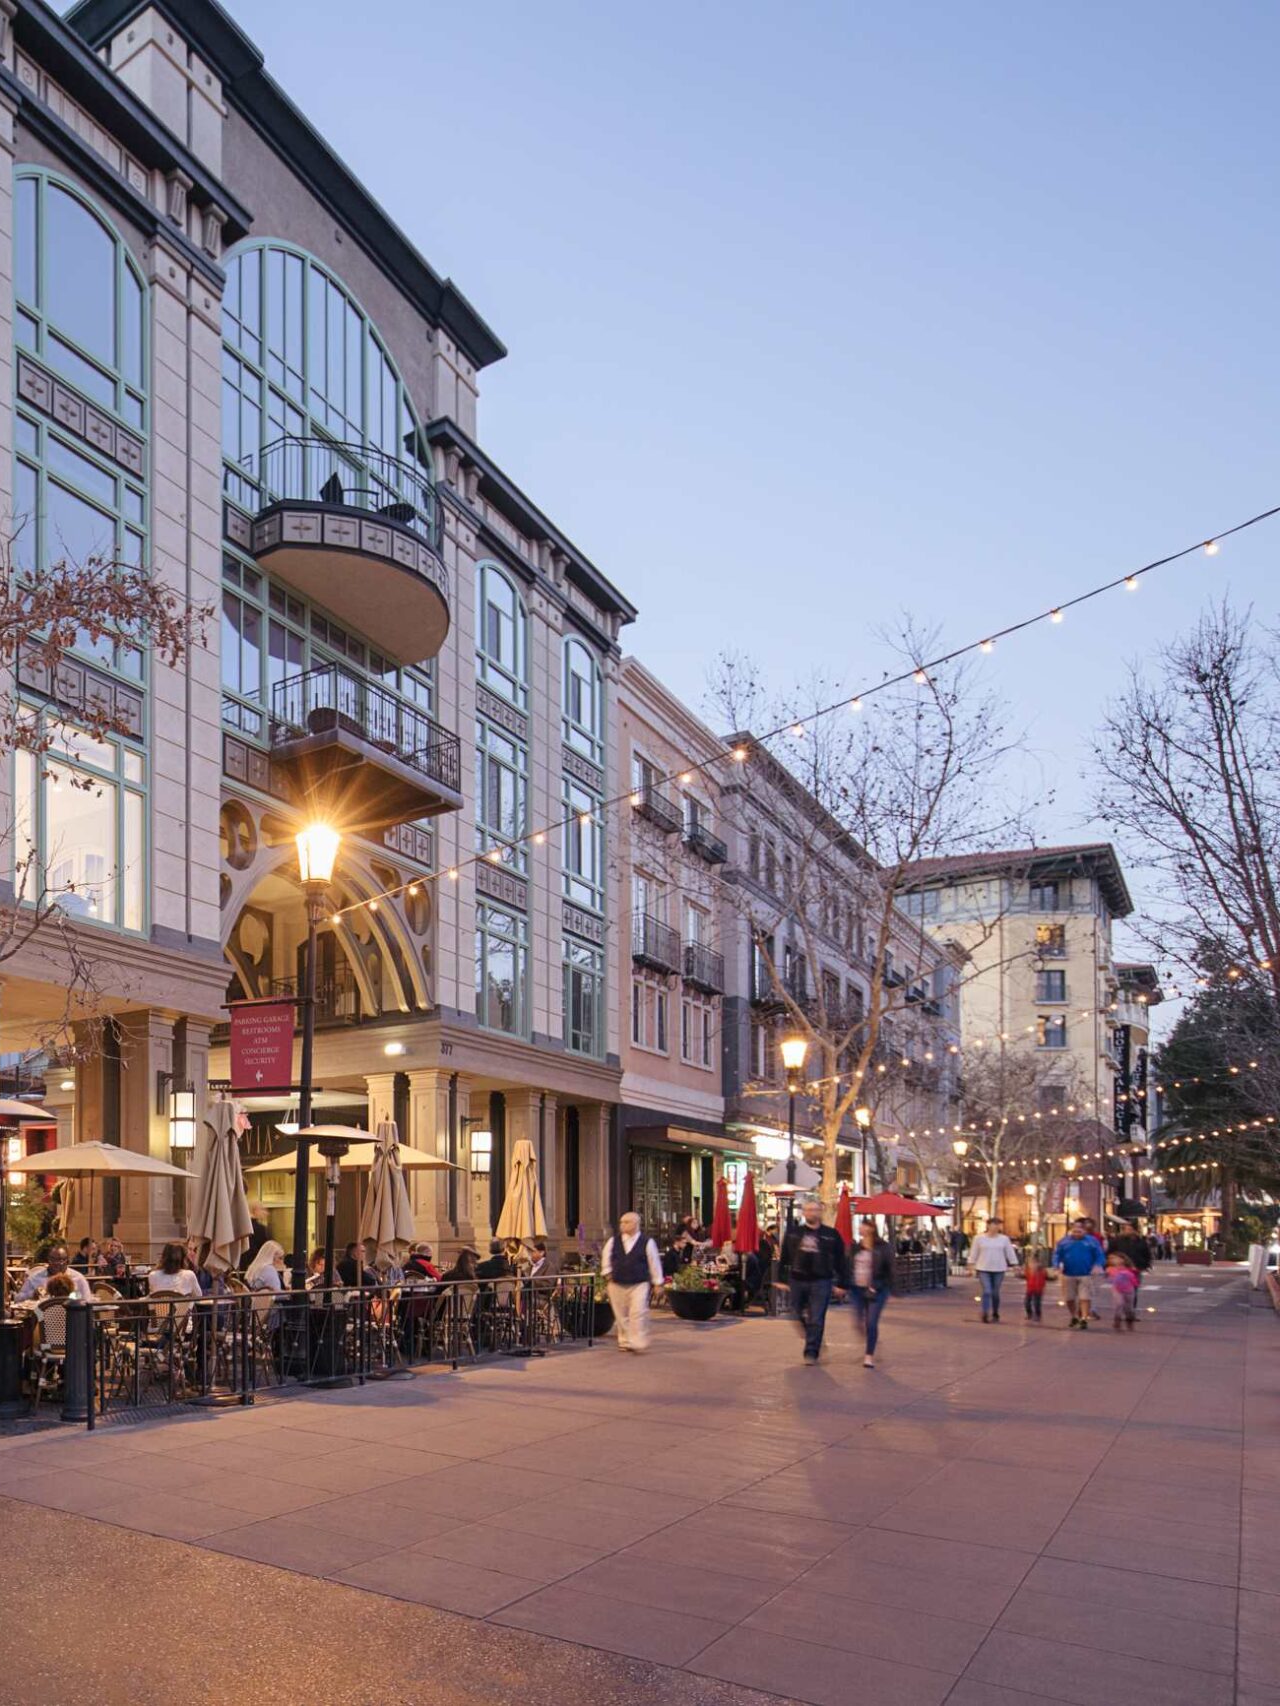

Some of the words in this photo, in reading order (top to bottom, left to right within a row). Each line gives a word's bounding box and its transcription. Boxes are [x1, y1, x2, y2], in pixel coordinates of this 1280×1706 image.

[234, 1016, 262, 1025] PARKING
[263, 1014, 289, 1023] GARAGE
[242, 1026, 281, 1035] RESTROOMS
[241, 1046, 280, 1055] CONCIERGE
[1115, 1030, 1125, 1062] HOTE
[244, 1057, 276, 1065] SECURITY
